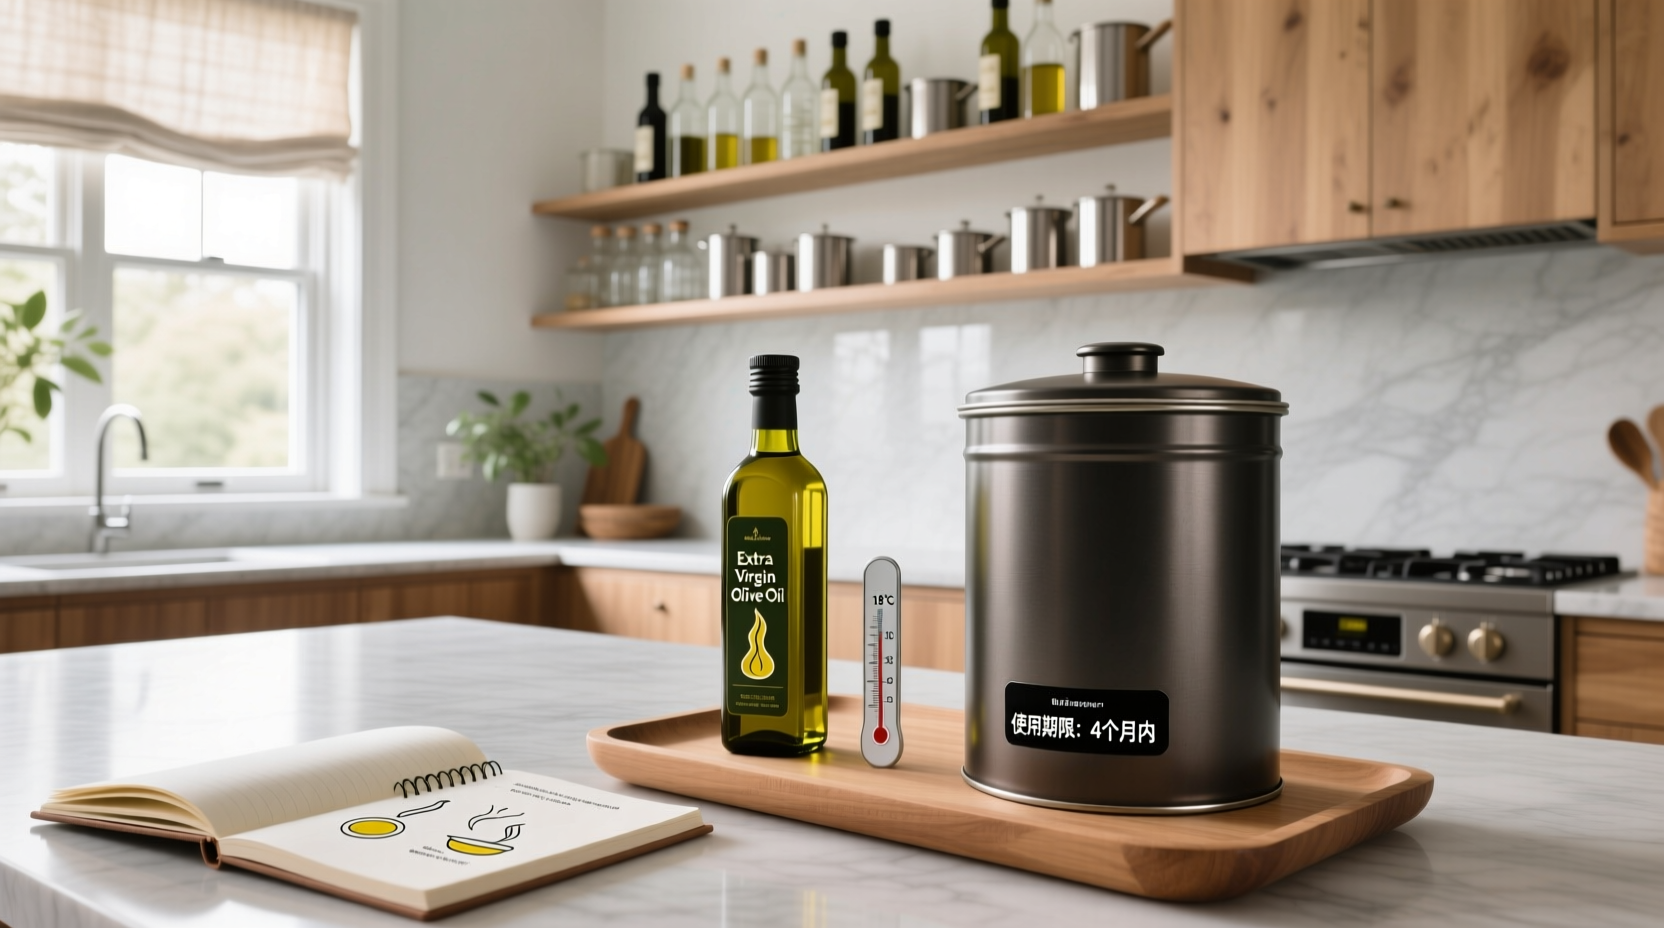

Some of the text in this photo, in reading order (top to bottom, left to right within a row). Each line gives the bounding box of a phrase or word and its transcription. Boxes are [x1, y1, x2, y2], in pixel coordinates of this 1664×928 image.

[737, 551, 774, 566] Extra
[734, 568, 776, 587] Virgin
[731, 587, 785, 603] Olive Oil
